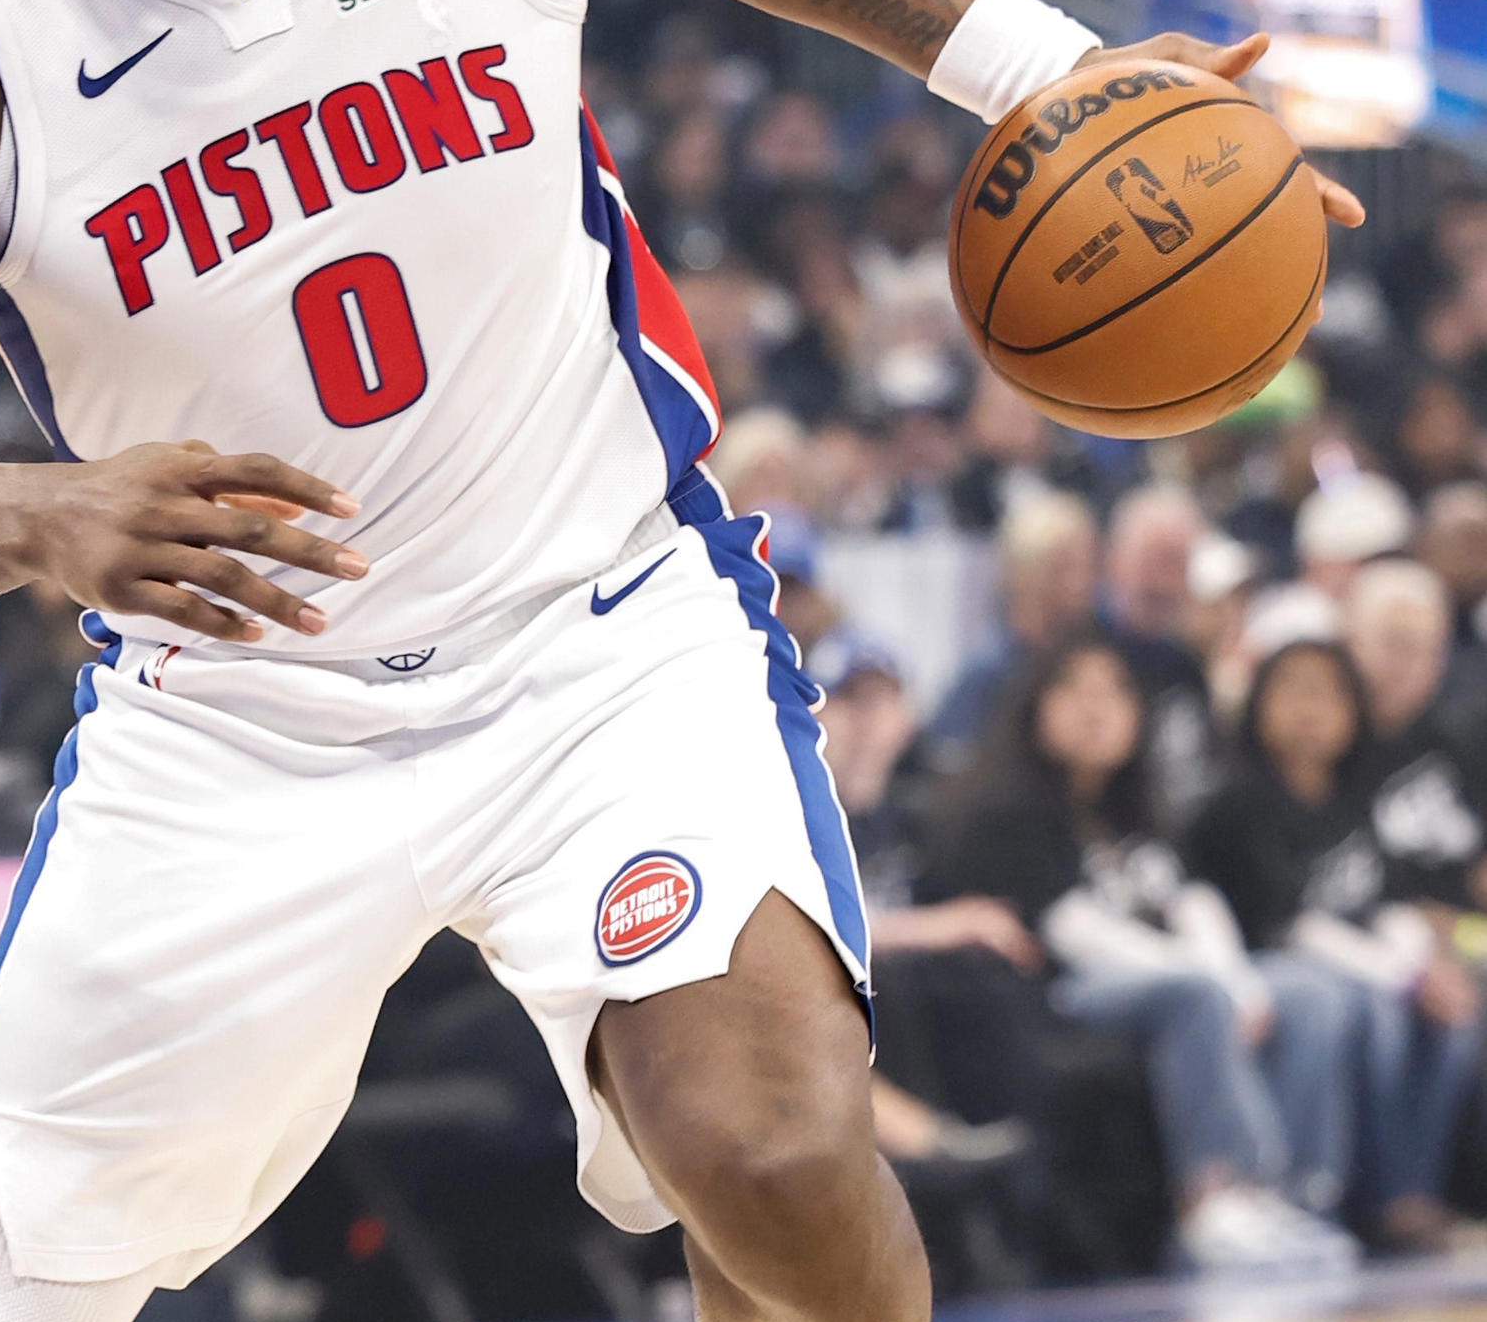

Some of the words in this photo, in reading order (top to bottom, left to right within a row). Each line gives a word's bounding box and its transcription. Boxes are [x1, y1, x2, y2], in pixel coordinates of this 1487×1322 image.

[85, 44, 535, 317] PISTONS
[973, 69, 1198, 220] Wilson
[292, 252, 428, 428] 0
[608, 876, 676, 920] DETROIT
[608, 893, 678, 942] PISTONS
